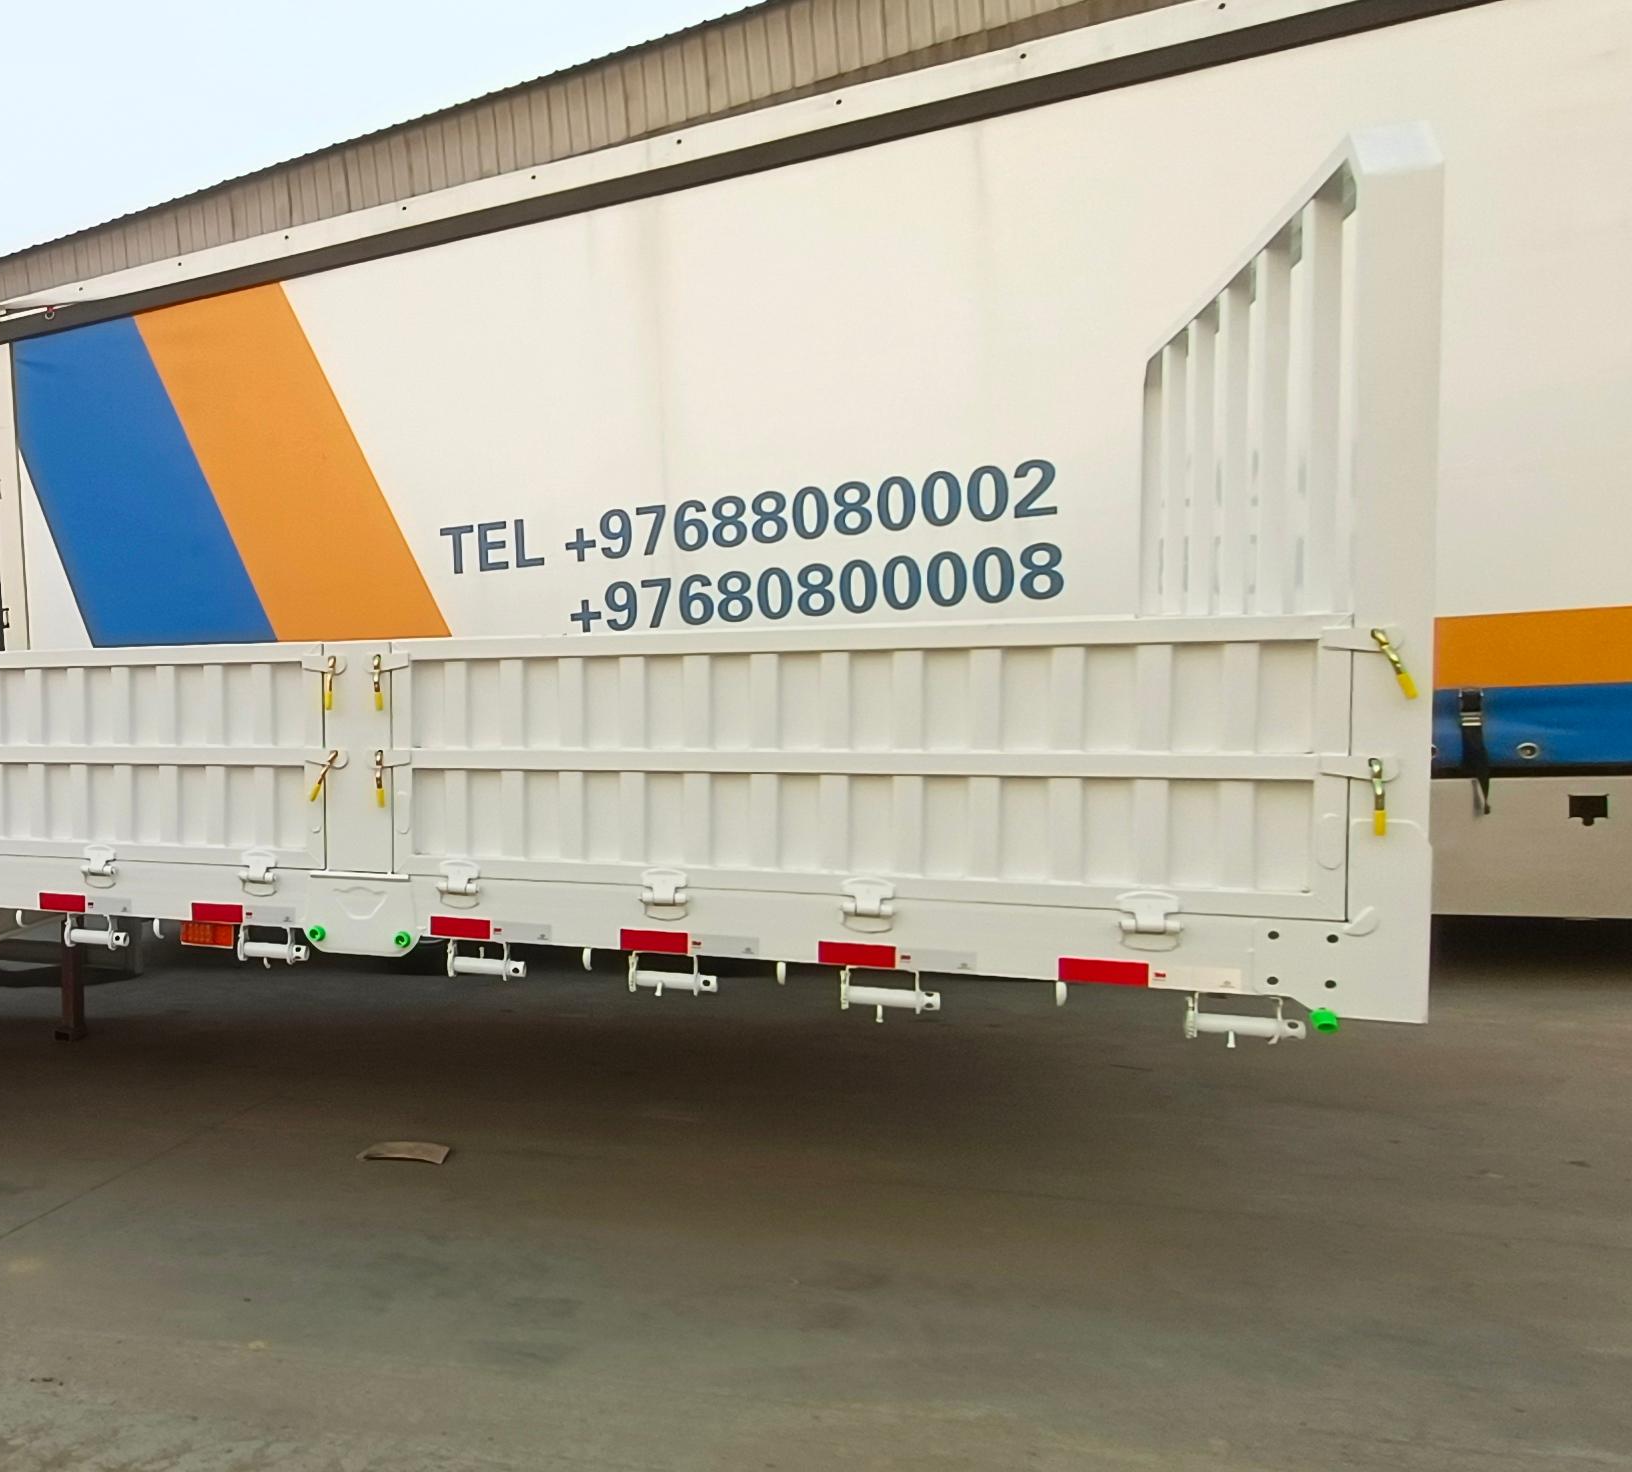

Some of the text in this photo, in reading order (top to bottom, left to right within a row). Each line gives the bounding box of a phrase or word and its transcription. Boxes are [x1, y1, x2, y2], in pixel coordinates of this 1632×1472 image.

[439, 459, 1058, 575] TEL +97688080002
[570, 542, 1065, 633] +97680800008
